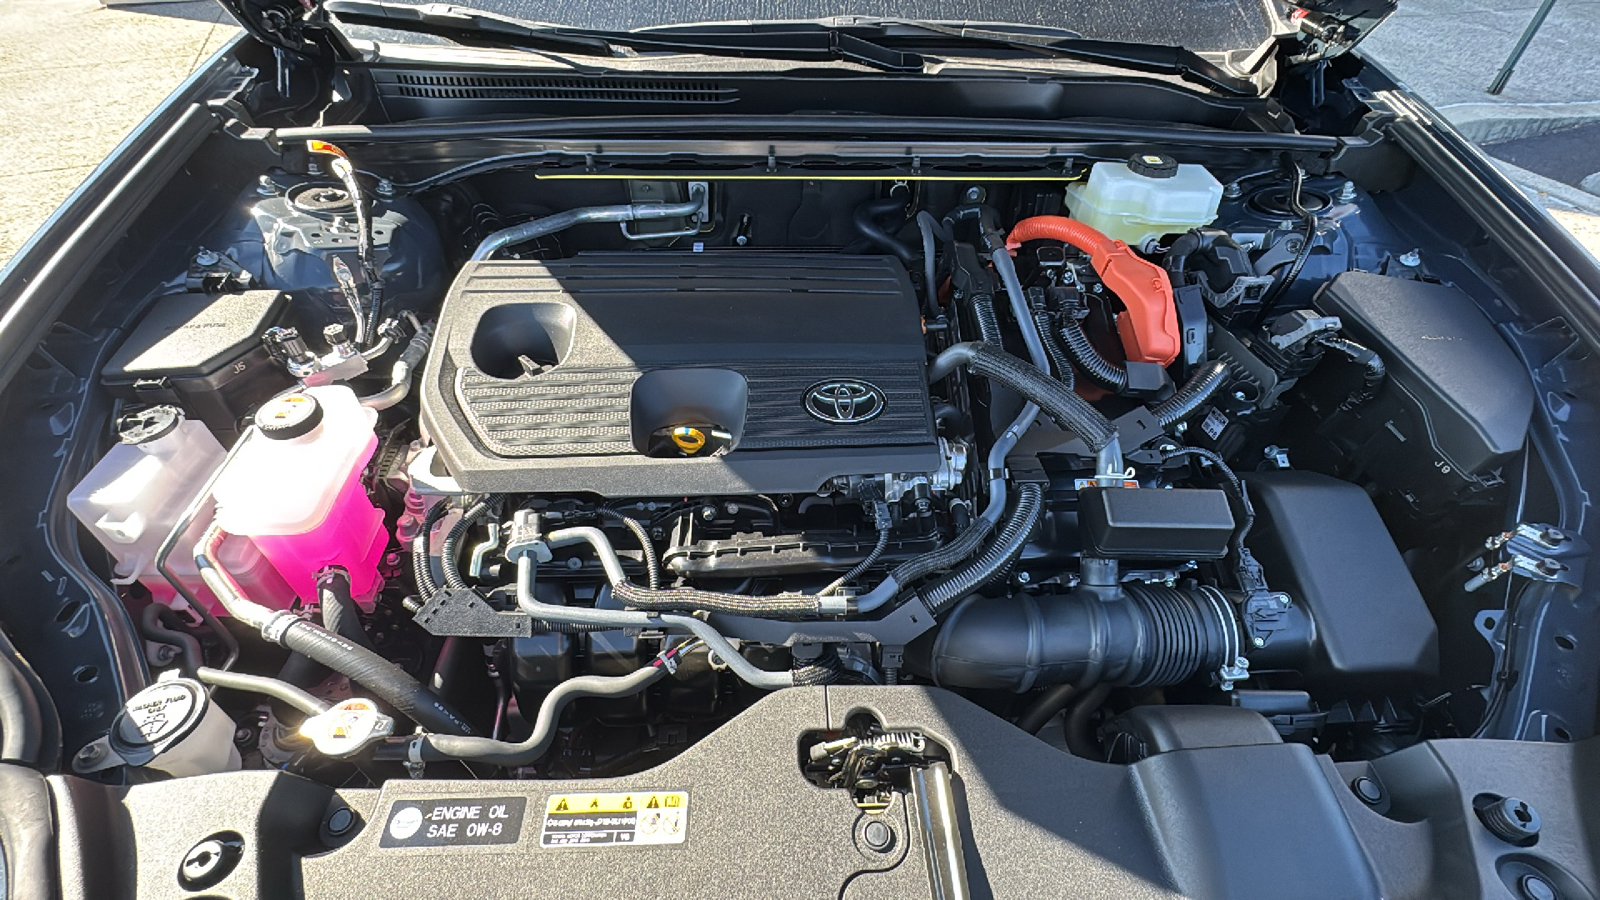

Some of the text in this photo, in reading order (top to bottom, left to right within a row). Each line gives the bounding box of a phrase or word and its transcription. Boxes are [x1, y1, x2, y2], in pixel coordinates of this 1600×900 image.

[431, 804, 509, 820] ENGINE OIL
[426, 822, 503, 838] SAE 0W-8
